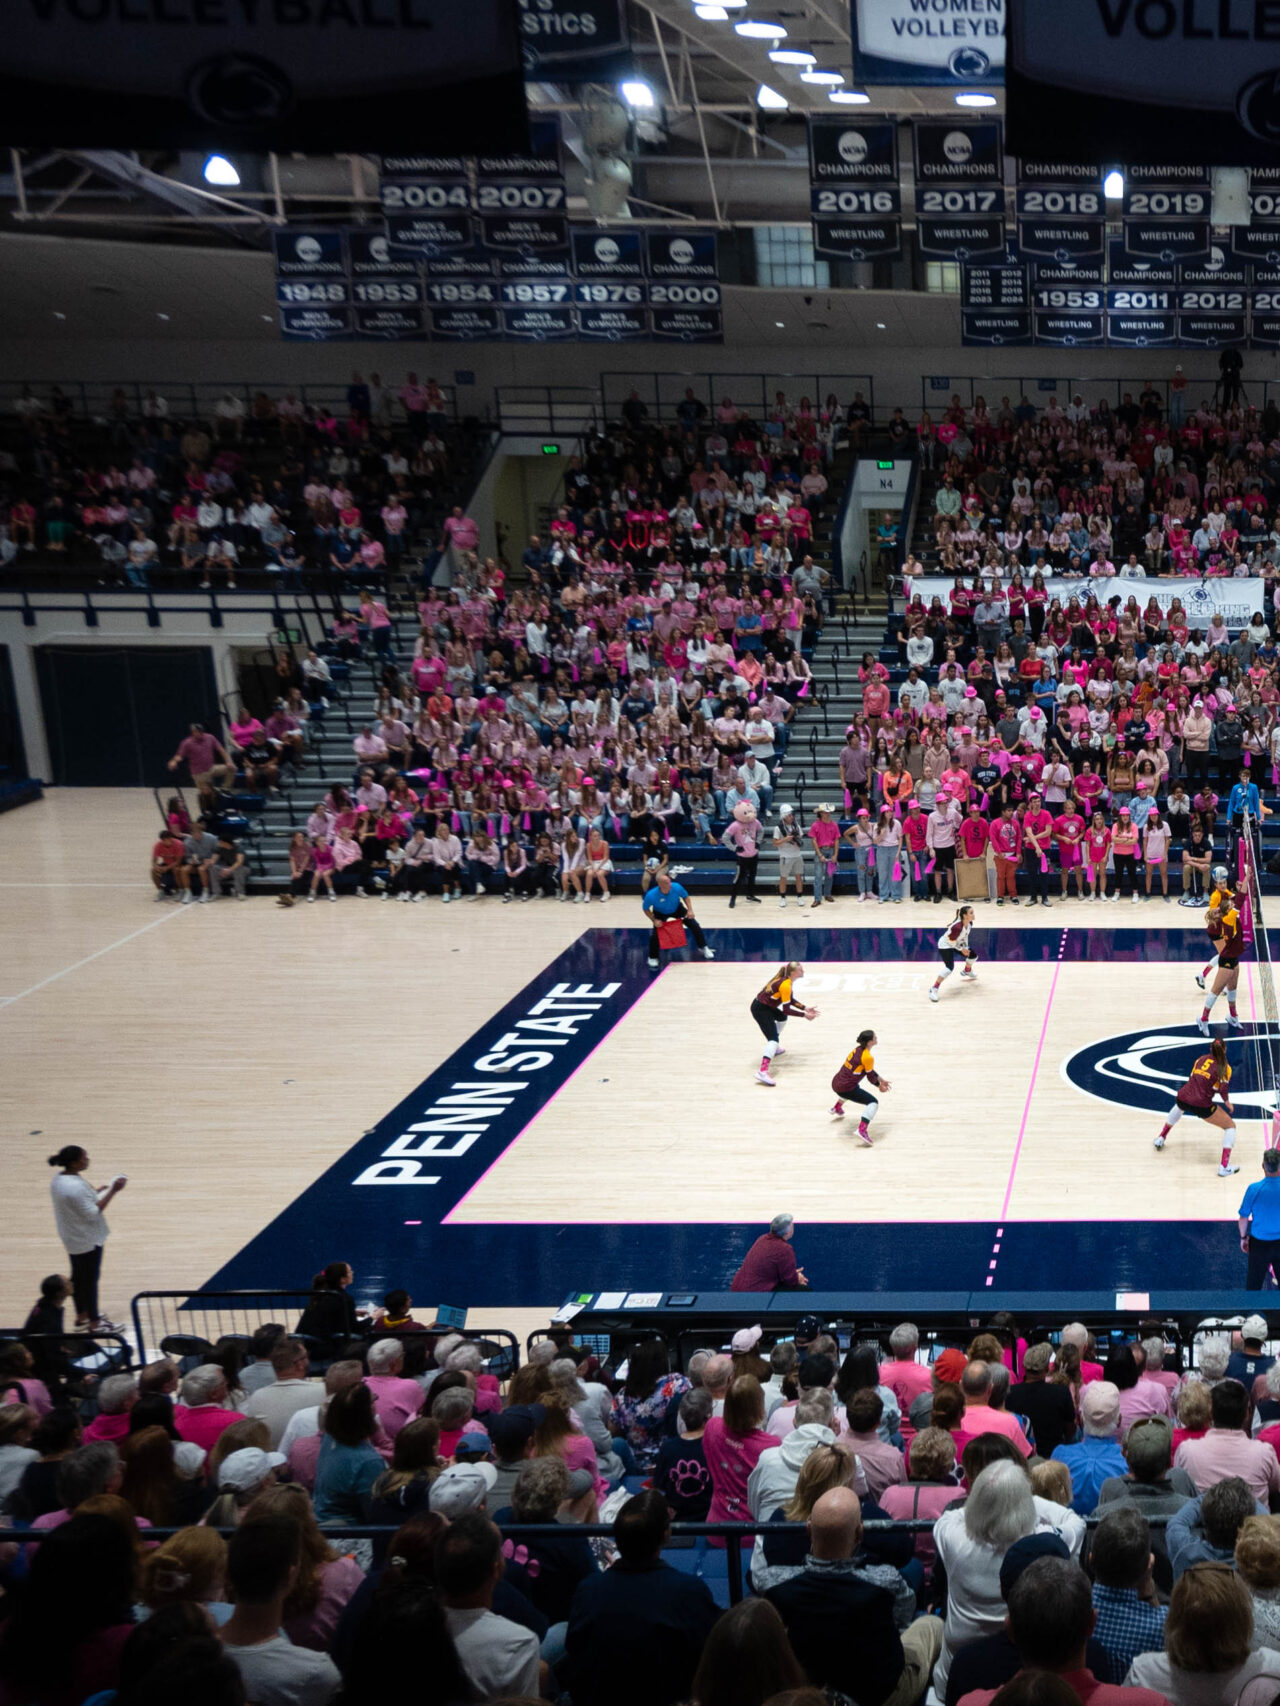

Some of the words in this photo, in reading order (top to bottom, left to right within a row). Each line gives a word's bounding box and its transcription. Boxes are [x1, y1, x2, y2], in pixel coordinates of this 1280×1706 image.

[892, 18, 1006, 36] VOLLEYB
[818, 163, 892, 176] CHAMPIONS
[923, 163, 995, 176] CHAMPIONS
[1025, 164, 1098, 177] CHAMPIONS
[1131, 165, 1203, 177] CHAMPIONS
[382, 185, 468, 208] 2004
[478, 186, 564, 209] 2007
[818, 190, 893, 213] 2016
[922, 191, 997, 212] 2017
[1023, 191, 1099, 214] 2018
[1129, 193, 1205, 214] 2019
[830, 228, 885, 240] WRESTLING
[933, 228, 989, 239] WRESTLING
[1034, 229, 1090, 241] WRESTLING
[1140, 230, 1195, 242] WRESTLING
[502, 262, 565, 274] CHAMPIONS
[578, 263, 641, 274] CHAMPIONS
[652, 264, 715, 275] CHAMPIONS
[1040, 269, 1099, 279] CHAMPIONS
[1113, 270, 1173, 280] CHAMPIONS
[1184, 271, 1243, 280] CHAMPIONS
[280, 283, 346, 301] 1948
[354, 283, 419, 301] 1953
[430, 284, 494, 301] 1954
[503, 284, 568, 302] 1957
[578, 284, 642, 302] 1976
[650, 286, 719, 304] 2000
[1038, 290, 1100, 308] 1953
[1114, 292, 1168, 309] 2011
[1182, 292, 1243, 309] 2012
[1047, 320, 1092, 329] WRESTLING
[1120, 321, 1165, 330] WRESTLING
[1190, 322, 1235, 330] WRESTLING
[880, 478, 893, 489] N4
[1201, 1059, 1214, 1071] 5
[352, 1082, 530, 1185] PENN
[473, 982, 623, 1073] STATE
[1246, 1362, 1255, 1374] S
